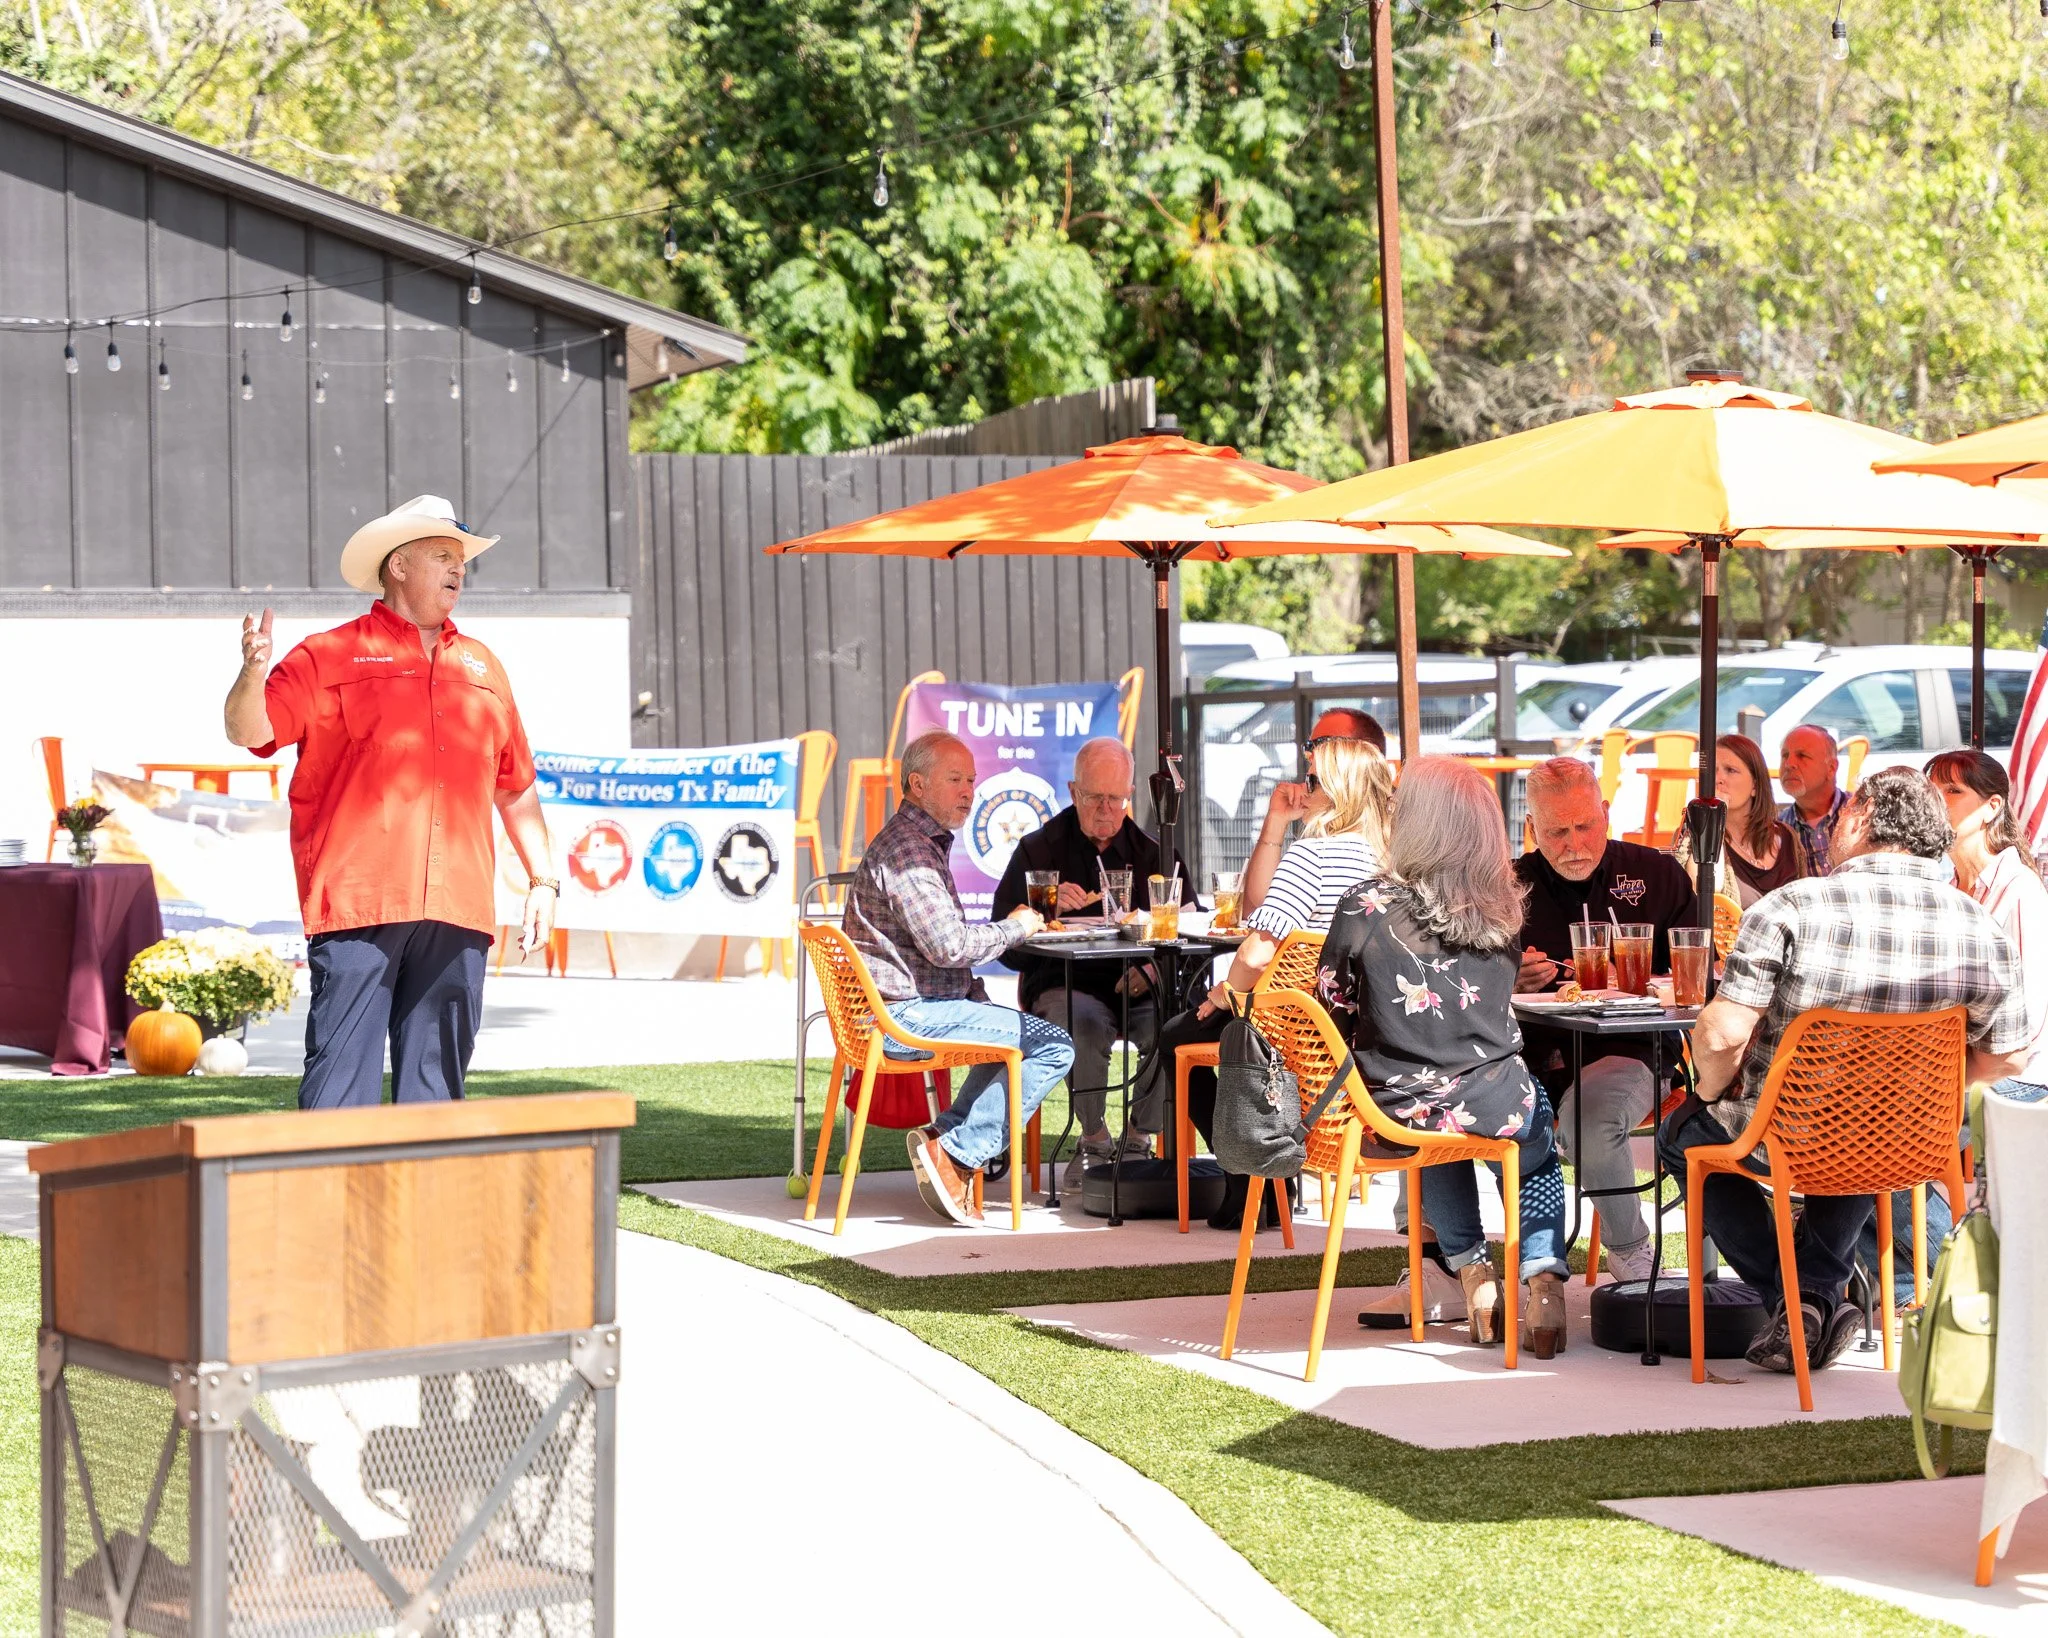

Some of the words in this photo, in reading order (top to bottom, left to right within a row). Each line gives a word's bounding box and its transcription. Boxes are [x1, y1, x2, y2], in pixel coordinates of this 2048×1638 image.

[941, 701, 1044, 737] TUNE
[1055, 701, 1094, 737] IN
[533, 754, 600, 773] ecome
[599, 760, 617, 775] a
[616, 757, 711, 776] Member
[711, 754, 741, 775] of
[740, 751, 777, 775] the
[996, 745, 1014, 760] for
[1015, 745, 1036, 760] the
[559, 776, 597, 799] For
[599, 778, 675, 802] Heroes
[677, 779, 708, 802] Tx
[711, 778, 787, 808] Family
